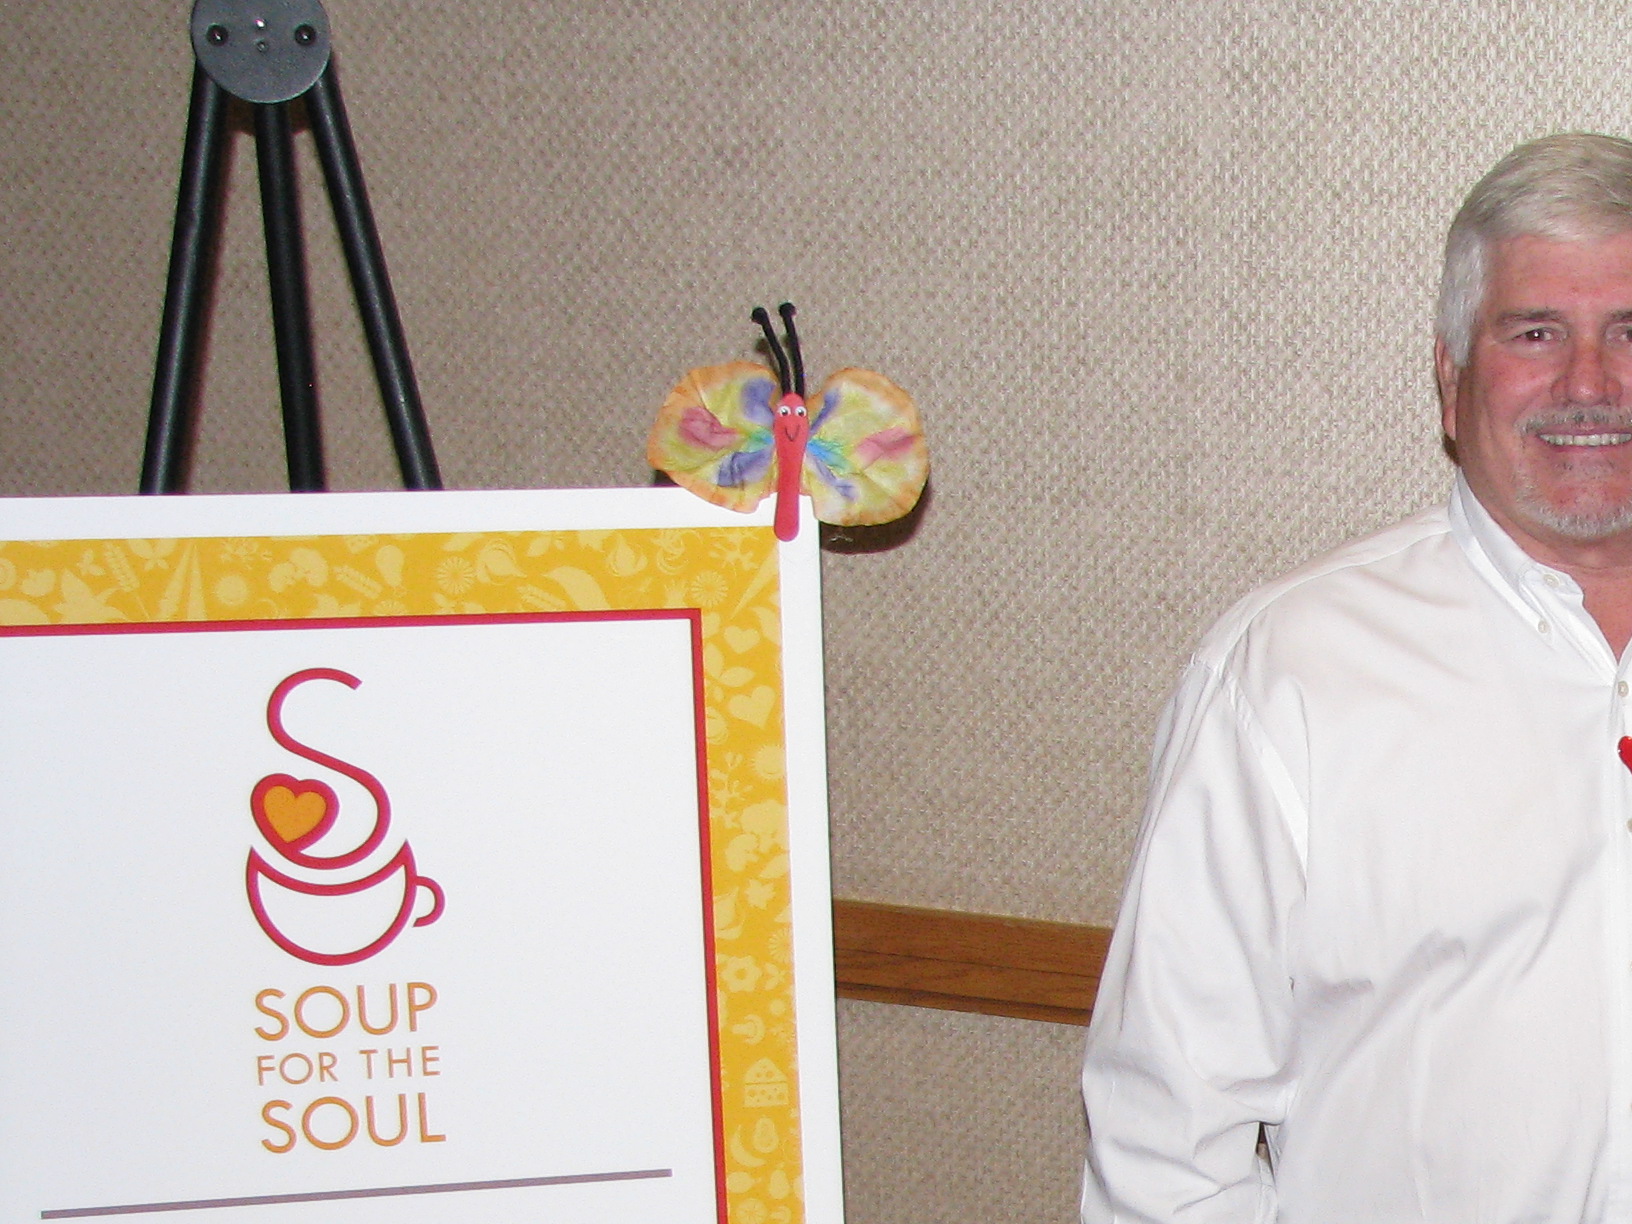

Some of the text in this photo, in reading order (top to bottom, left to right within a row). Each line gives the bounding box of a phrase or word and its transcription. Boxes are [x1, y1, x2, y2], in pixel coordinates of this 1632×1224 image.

[254, 983, 438, 1041] SOUP
[257, 1046, 440, 1085] FOR THE
[262, 1094, 446, 1153] SOUL
